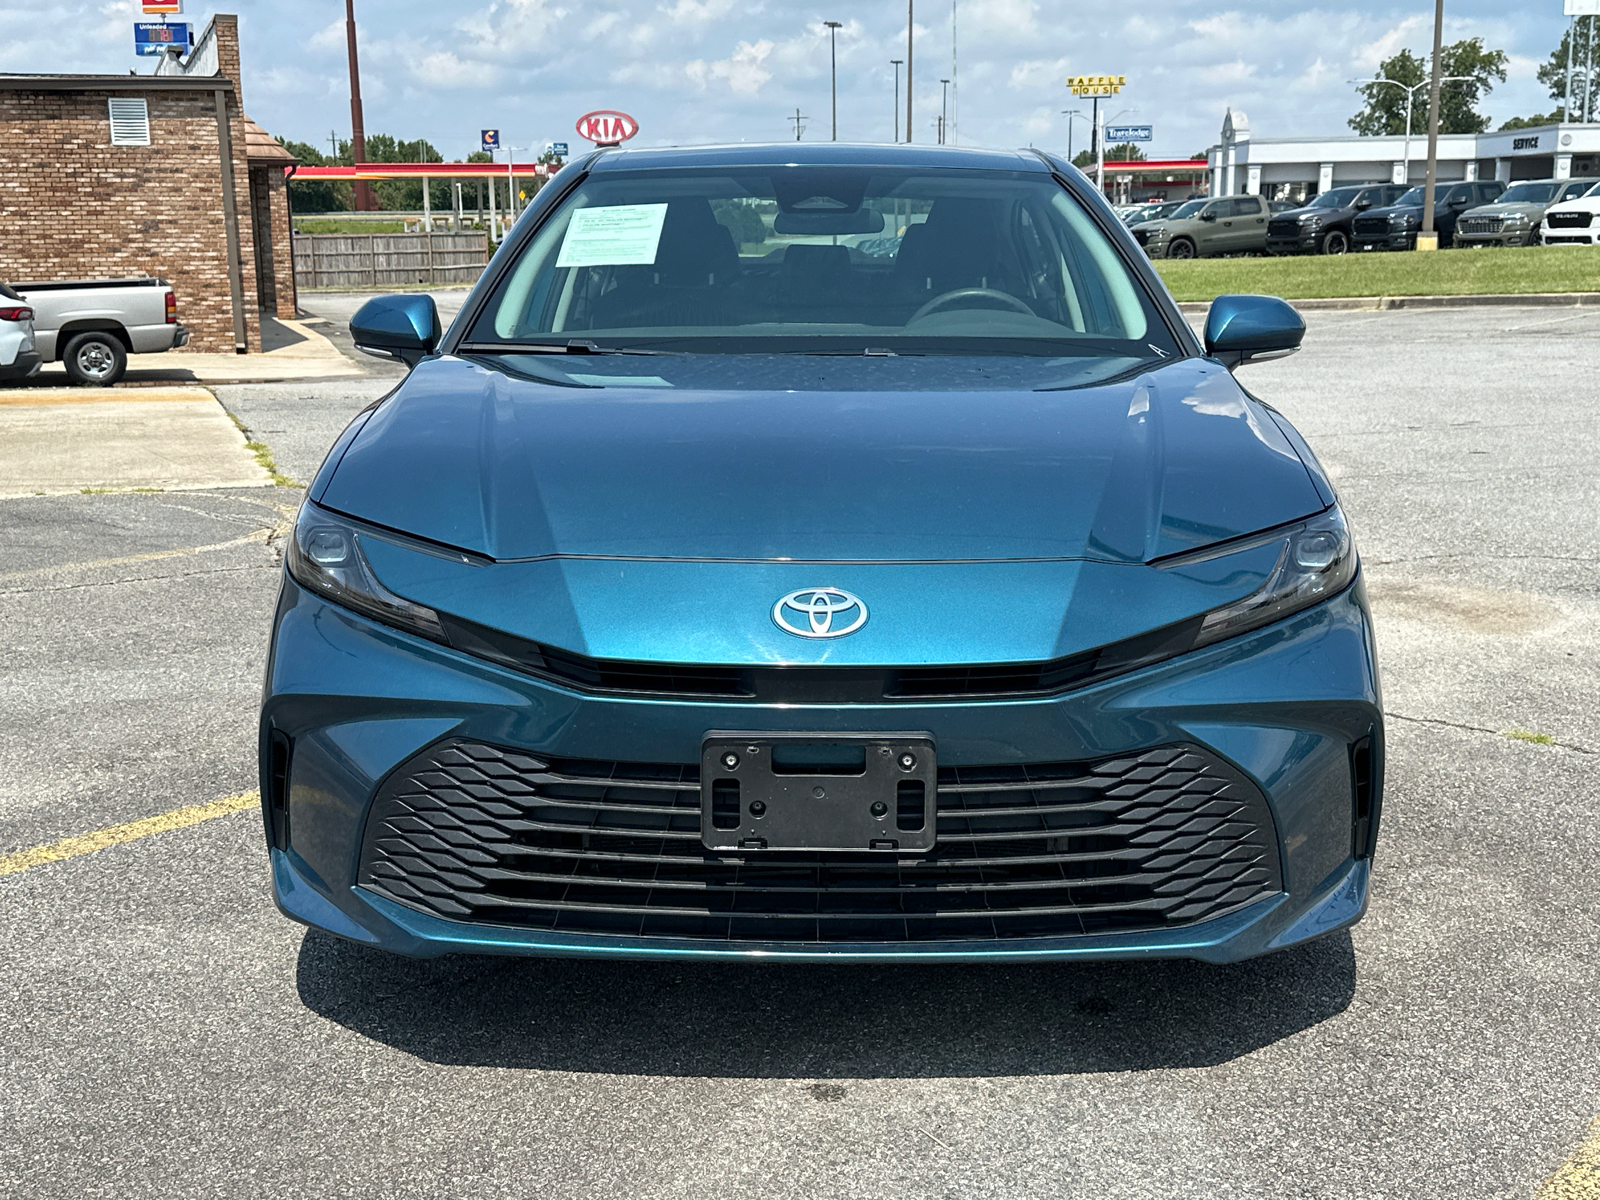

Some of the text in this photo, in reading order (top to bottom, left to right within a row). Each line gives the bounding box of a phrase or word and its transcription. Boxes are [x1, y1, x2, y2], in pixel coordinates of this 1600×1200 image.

[1072, 86, 1119, 94] HOUSE
[586, 118, 627, 138] KIA
[1108, 128, 1150, 137] Travelodge
[1513, 136, 1539, 150] SERVICE
